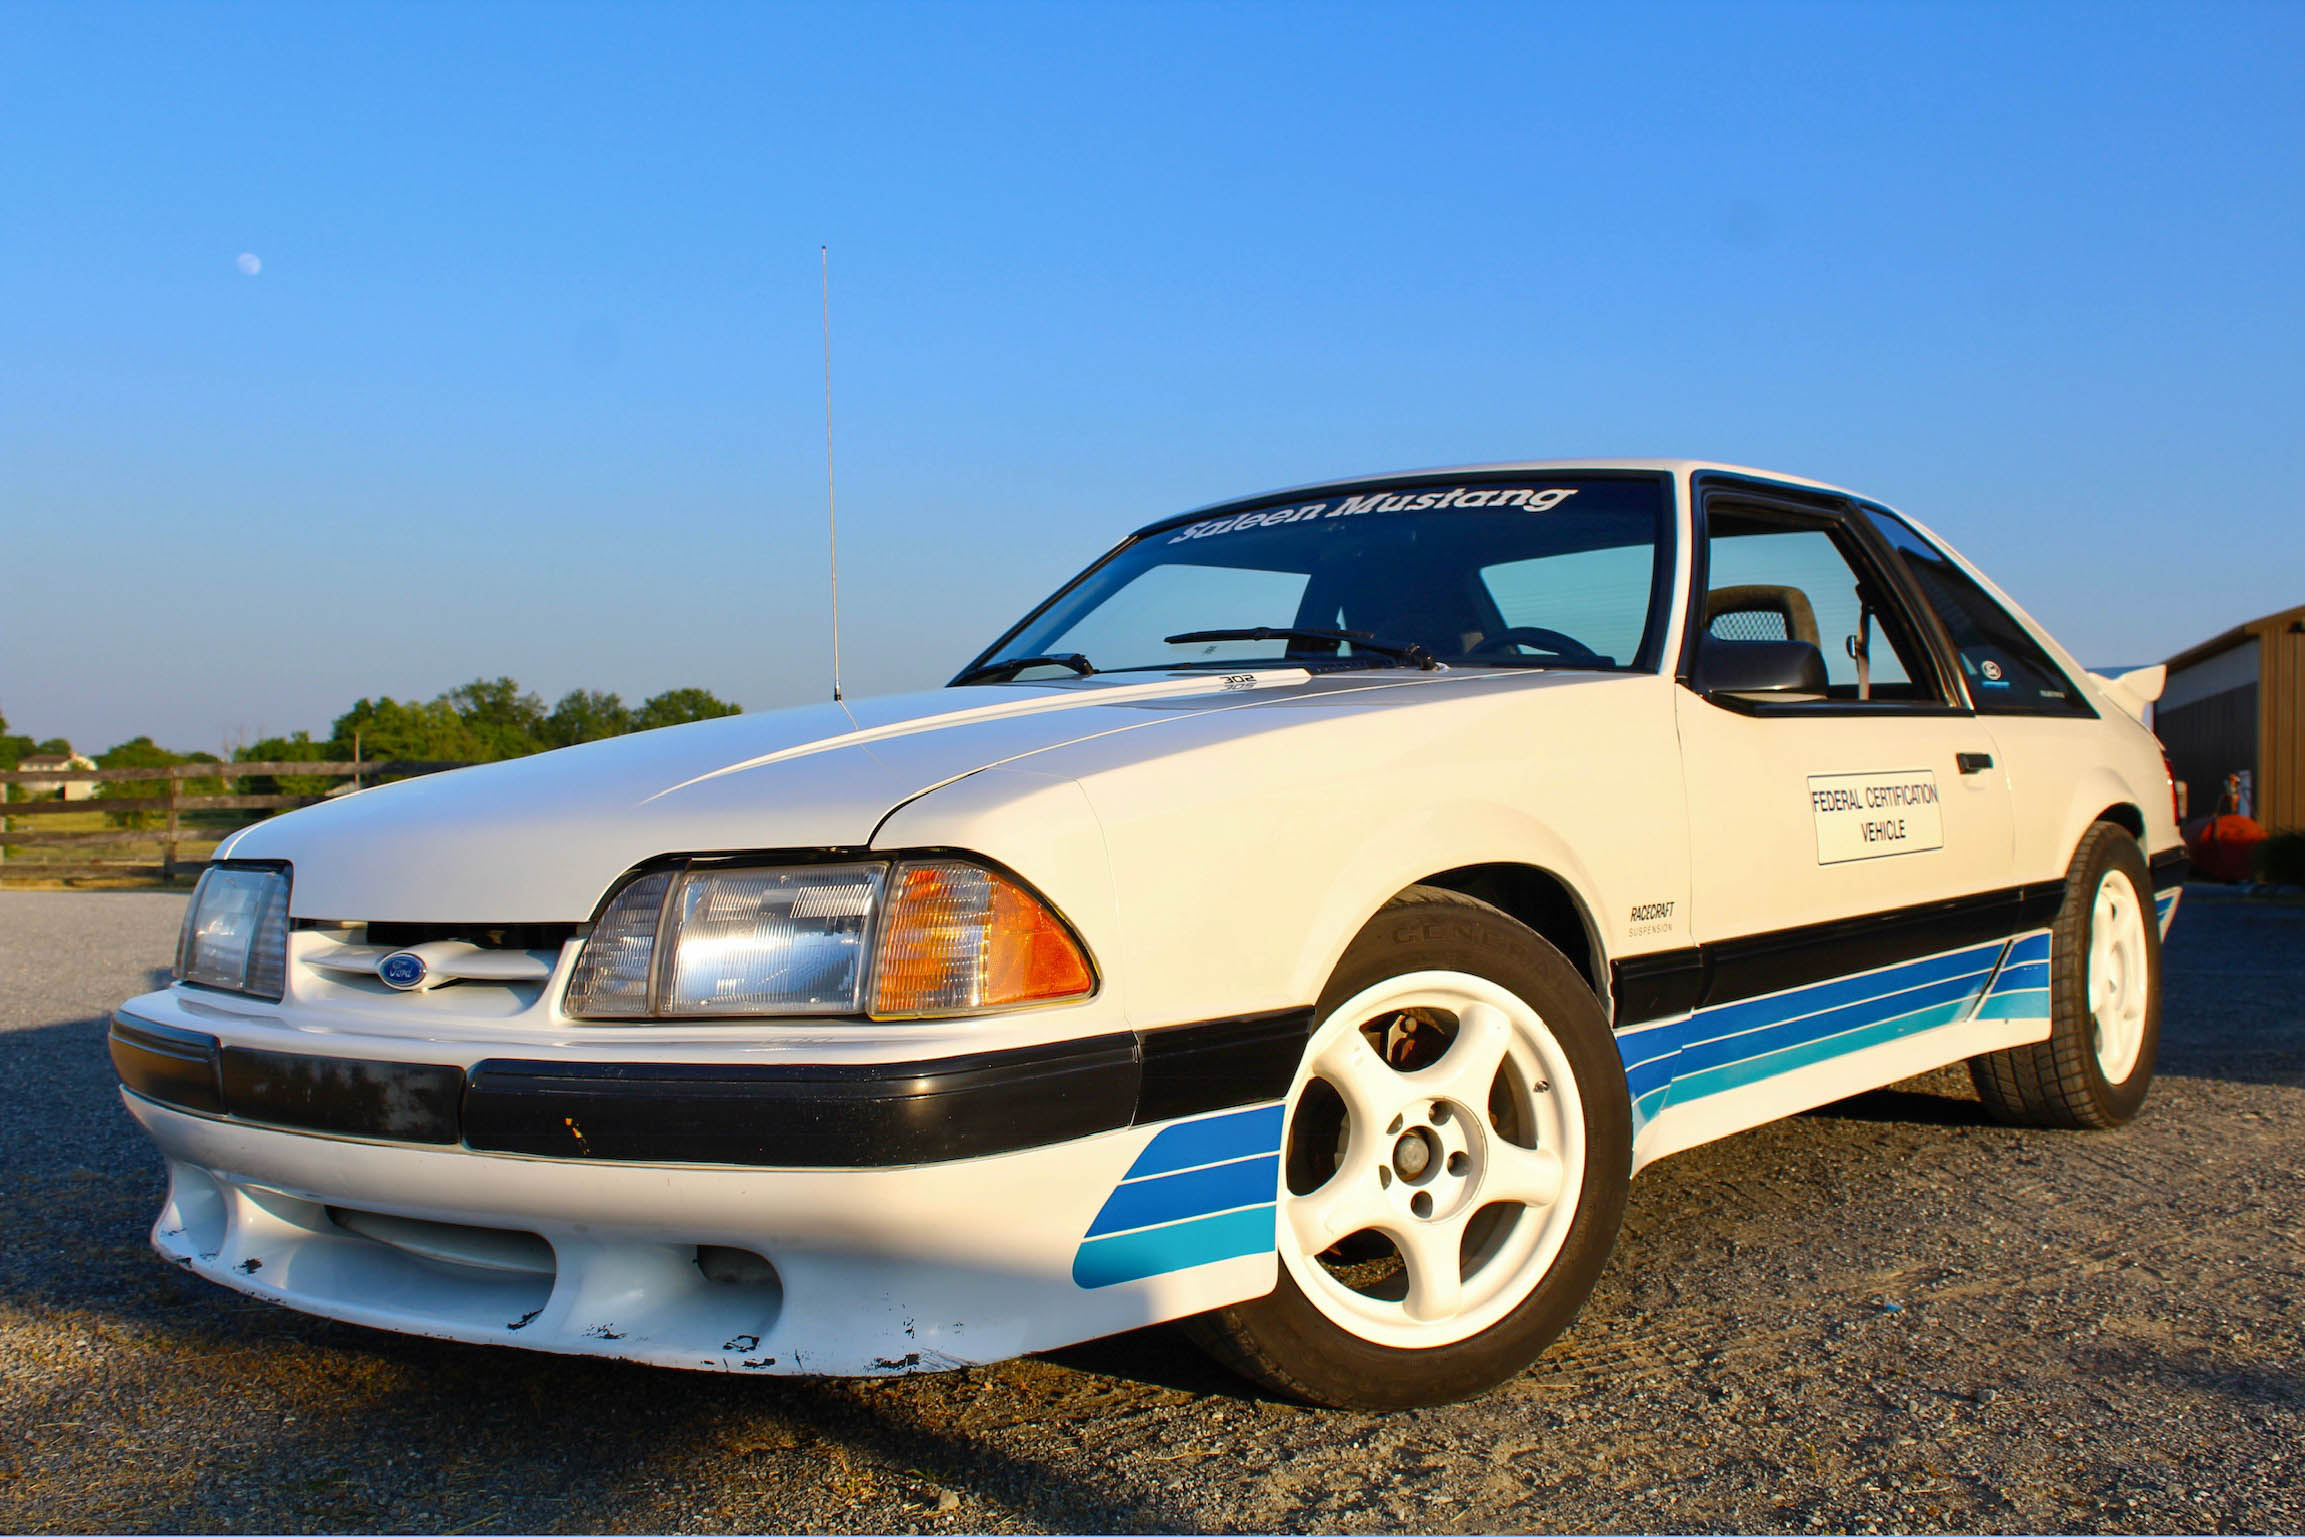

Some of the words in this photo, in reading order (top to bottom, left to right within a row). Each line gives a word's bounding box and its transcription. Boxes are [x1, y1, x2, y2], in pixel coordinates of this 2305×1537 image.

[1167, 503, 1327, 545] Saleen
[1324, 487, 1579, 513] Mustang
[1219, 673, 1257, 684] 302
[1812, 788, 1864, 812] FEDERAL
[1865, 783, 1939, 809] CERTIFICATION
[1861, 819, 1906, 842] VEHICLE
[1630, 901, 1675, 922] RACECRAFT
[1628, 923, 1673, 938] SUSPENSION
